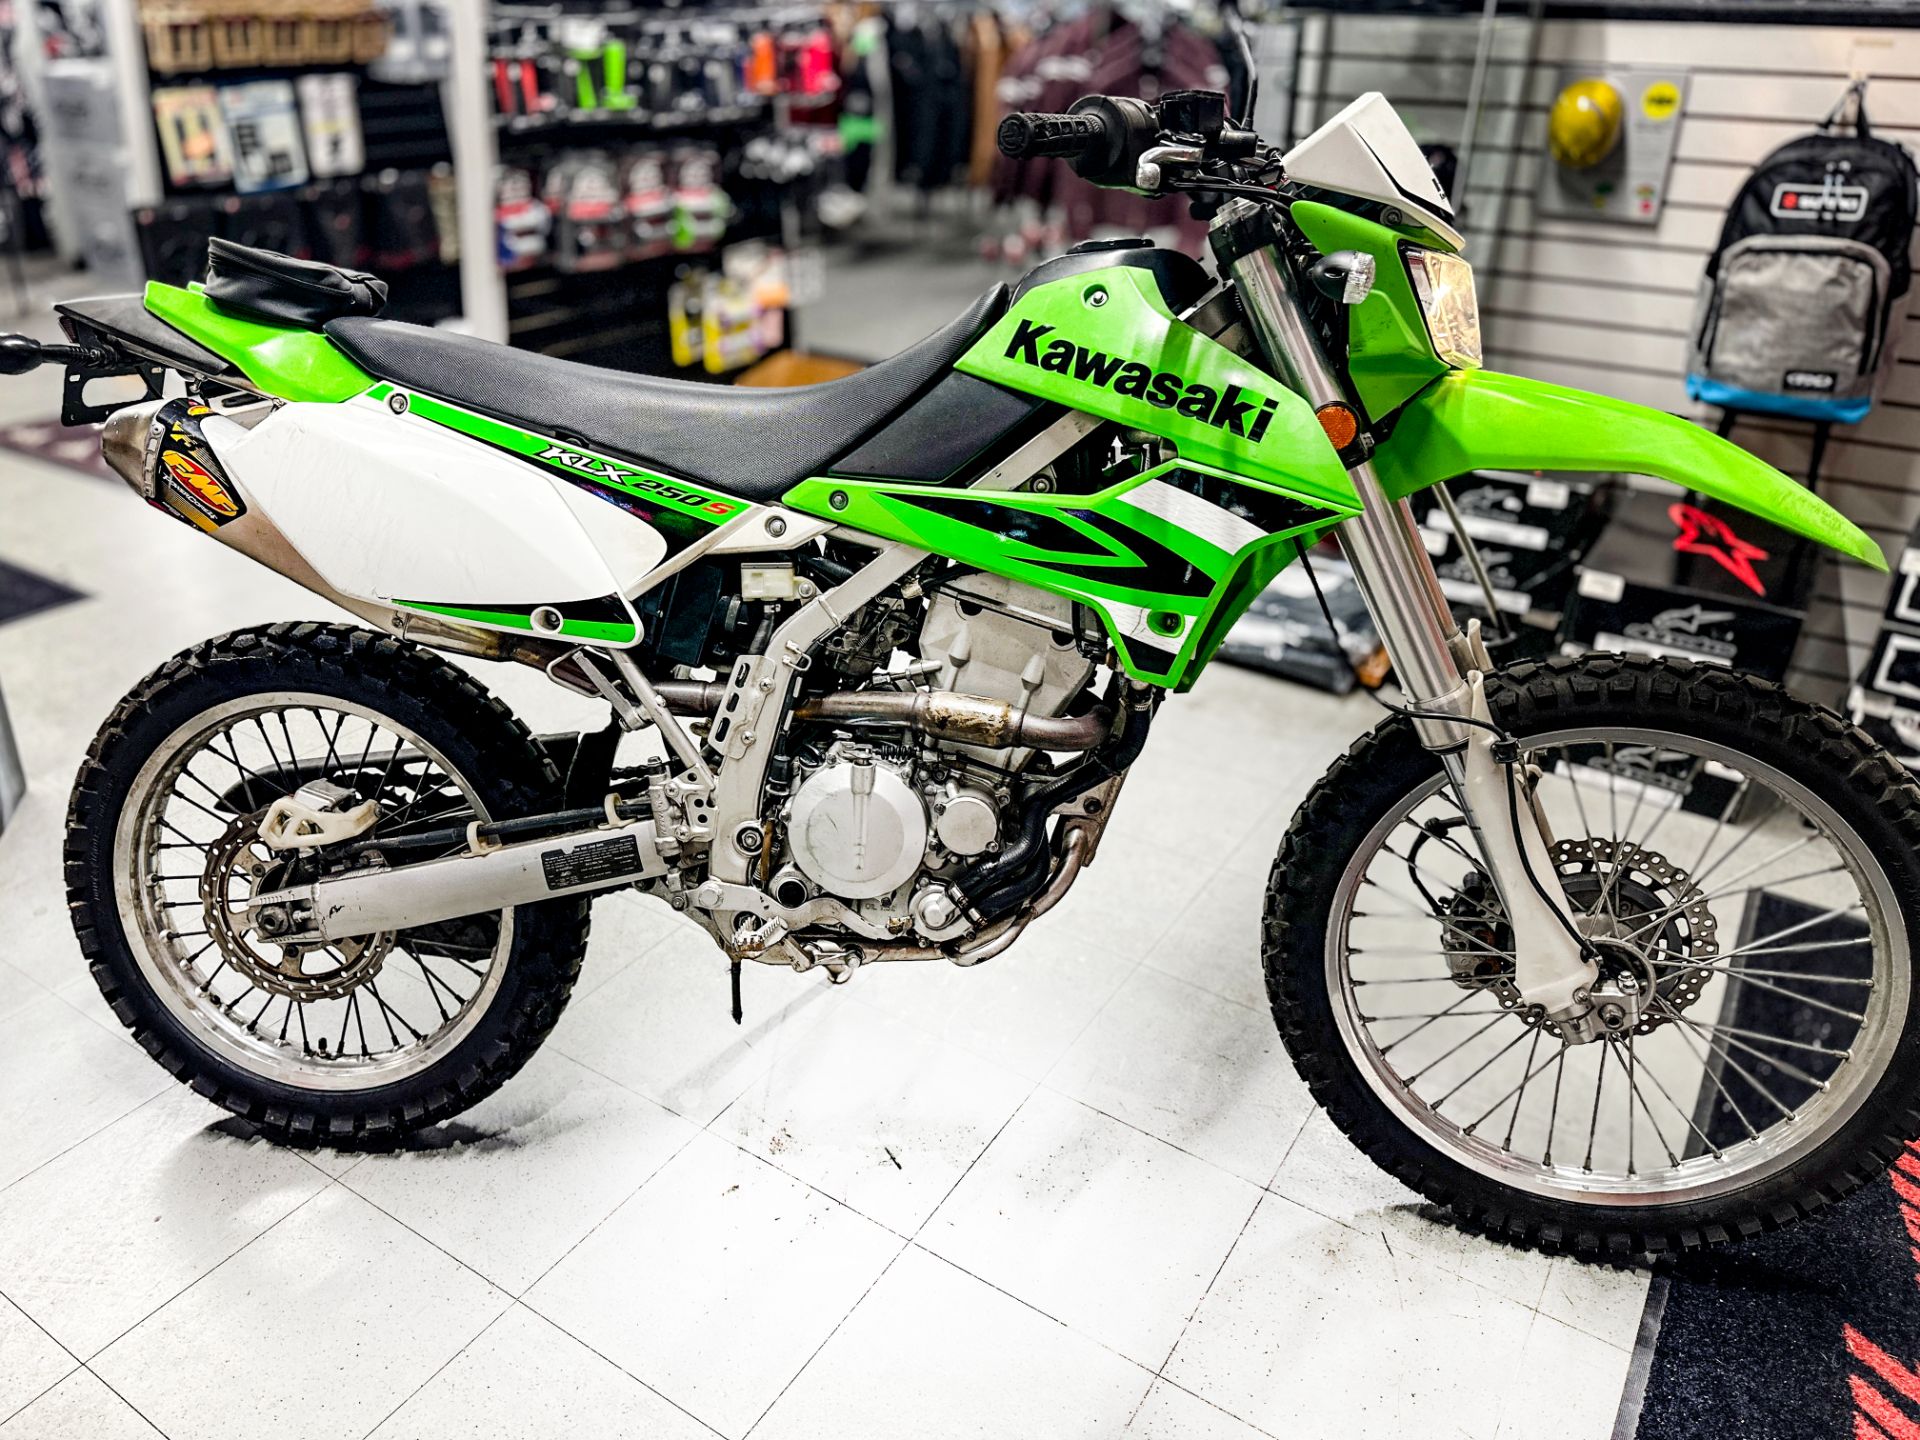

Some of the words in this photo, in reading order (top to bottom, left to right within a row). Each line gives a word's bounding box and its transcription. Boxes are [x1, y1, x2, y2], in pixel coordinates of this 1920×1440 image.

[1004, 319, 1280, 444] Kawasaki
[161, 452, 239, 512] FMF
[537, 445, 637, 485] KLX
